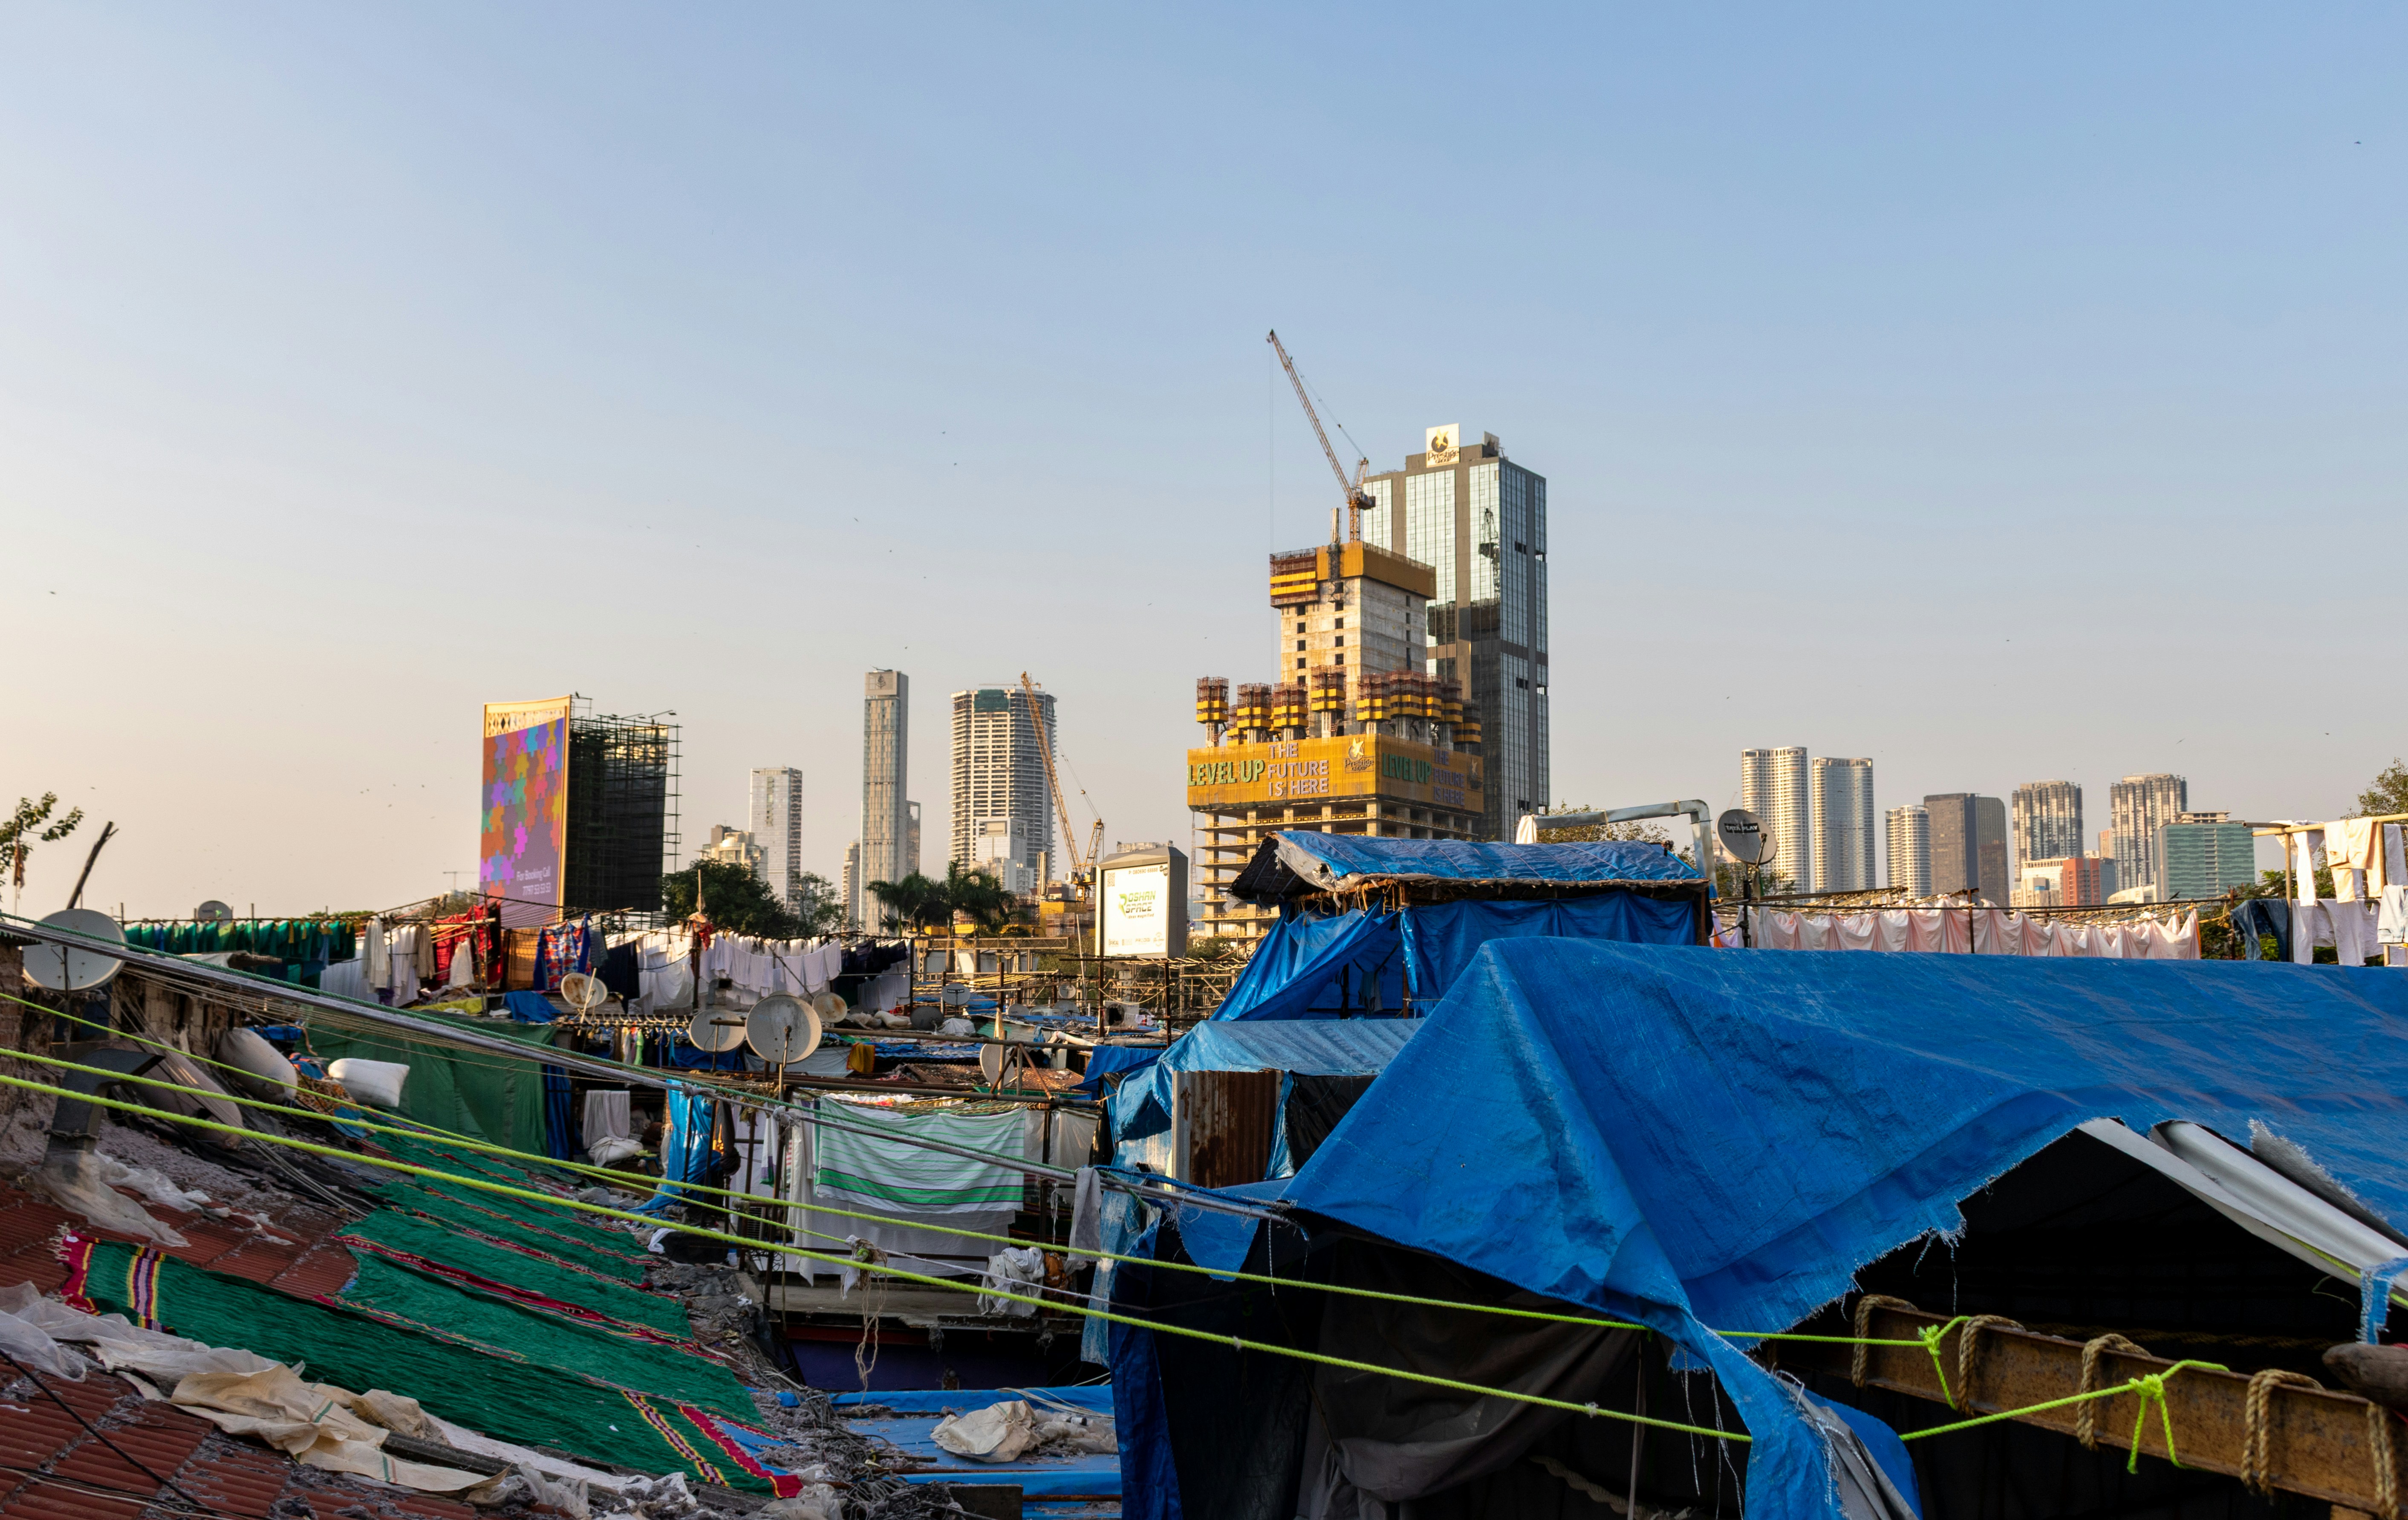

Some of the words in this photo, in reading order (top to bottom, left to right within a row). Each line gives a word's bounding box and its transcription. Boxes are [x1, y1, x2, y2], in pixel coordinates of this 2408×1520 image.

[1428, 449, 1459, 461] Prestige
[1268, 743, 1298, 759] THE
[1434, 748, 1449, 766] THE
[1268, 760, 1328, 779] FUTURE
[1344, 758, 1374, 768] Prestige
[1382, 752, 1415, 781] LEVEL
[1416, 759, 1432, 784] UP
[1187, 762, 1236, 786] LEVEL
[1240, 760, 1265, 783] UP
[1433, 768, 1465, 788] FUTURE
[1269, 781, 1284, 797] IS
[1290, 778, 1328, 795] HERE
[1433, 786, 1442, 802] IS
[1443, 788, 1465, 806] HERE
[525, 869, 542, 881] Booking
[543, 866, 551, 877] Call
[1126, 902, 1152, 913] SPACE
